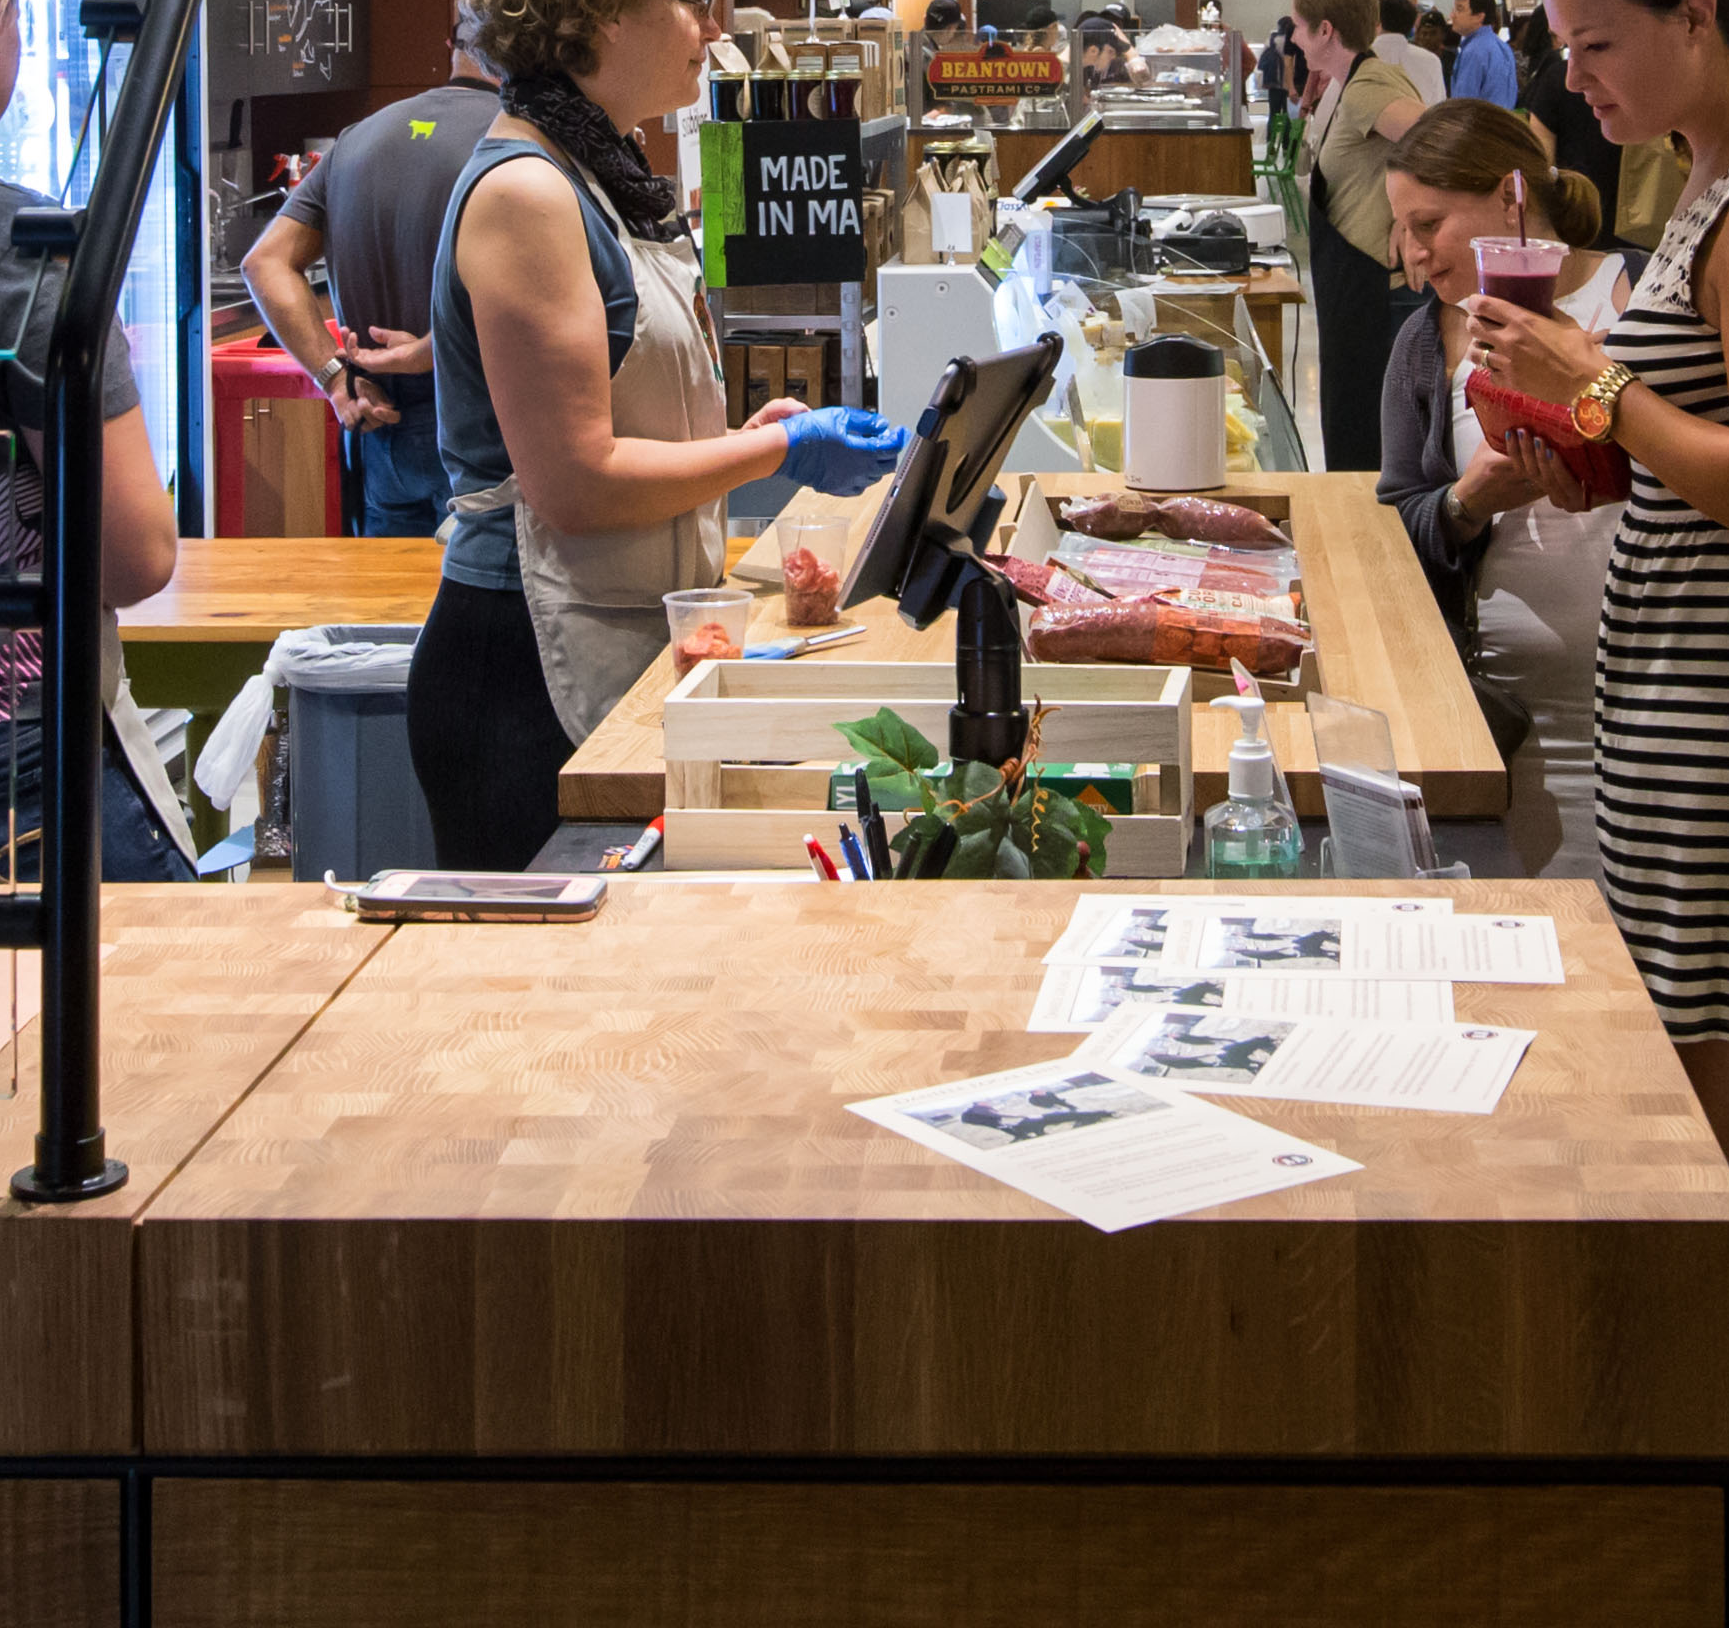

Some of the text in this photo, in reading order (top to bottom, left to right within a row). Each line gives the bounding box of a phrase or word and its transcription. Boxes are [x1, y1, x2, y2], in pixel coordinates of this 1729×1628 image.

[941, 61, 1051, 78] BEANTOWN
[950, 85, 1021, 94] PASTRAMI
[759, 154, 848, 192] MADE
[757, 198, 861, 237] IN MA
